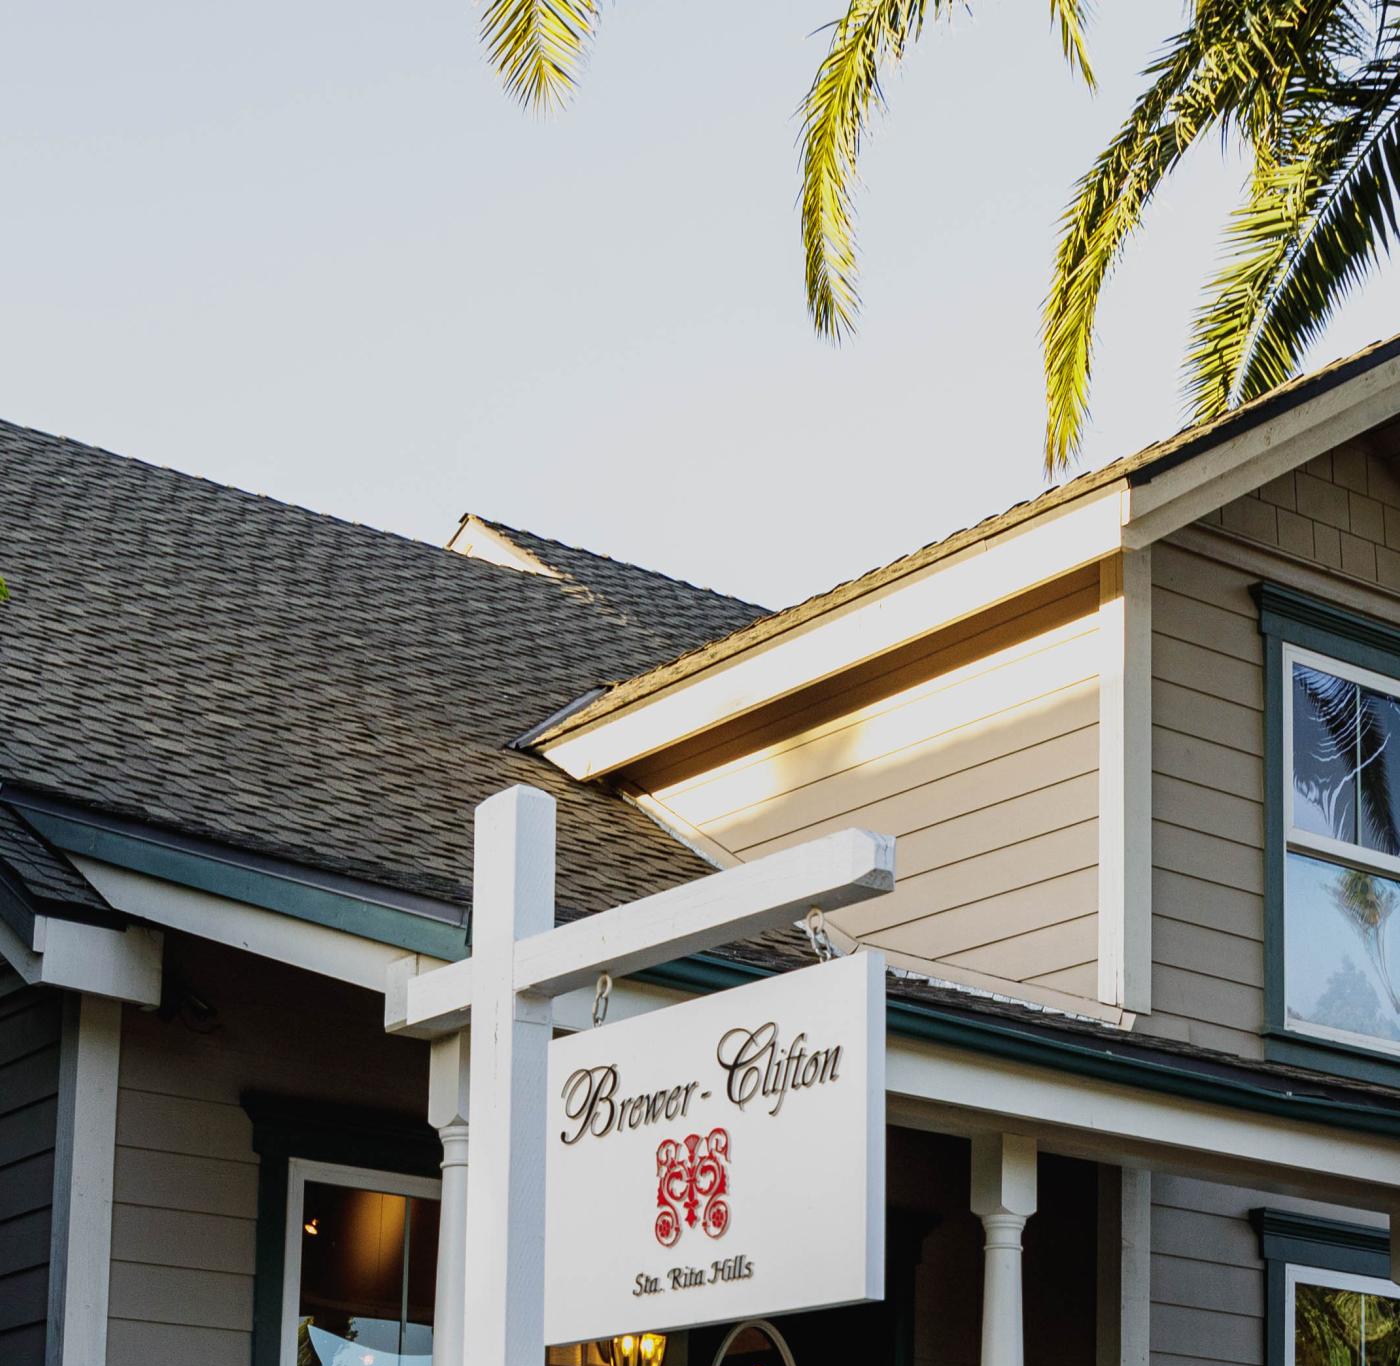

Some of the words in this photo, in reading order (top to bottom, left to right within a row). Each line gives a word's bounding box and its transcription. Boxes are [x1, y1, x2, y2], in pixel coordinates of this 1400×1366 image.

[633, 1272, 664, 1297] Sta.
[667, 1265, 706, 1289] Rita
[708, 1255, 754, 1283] Hills
